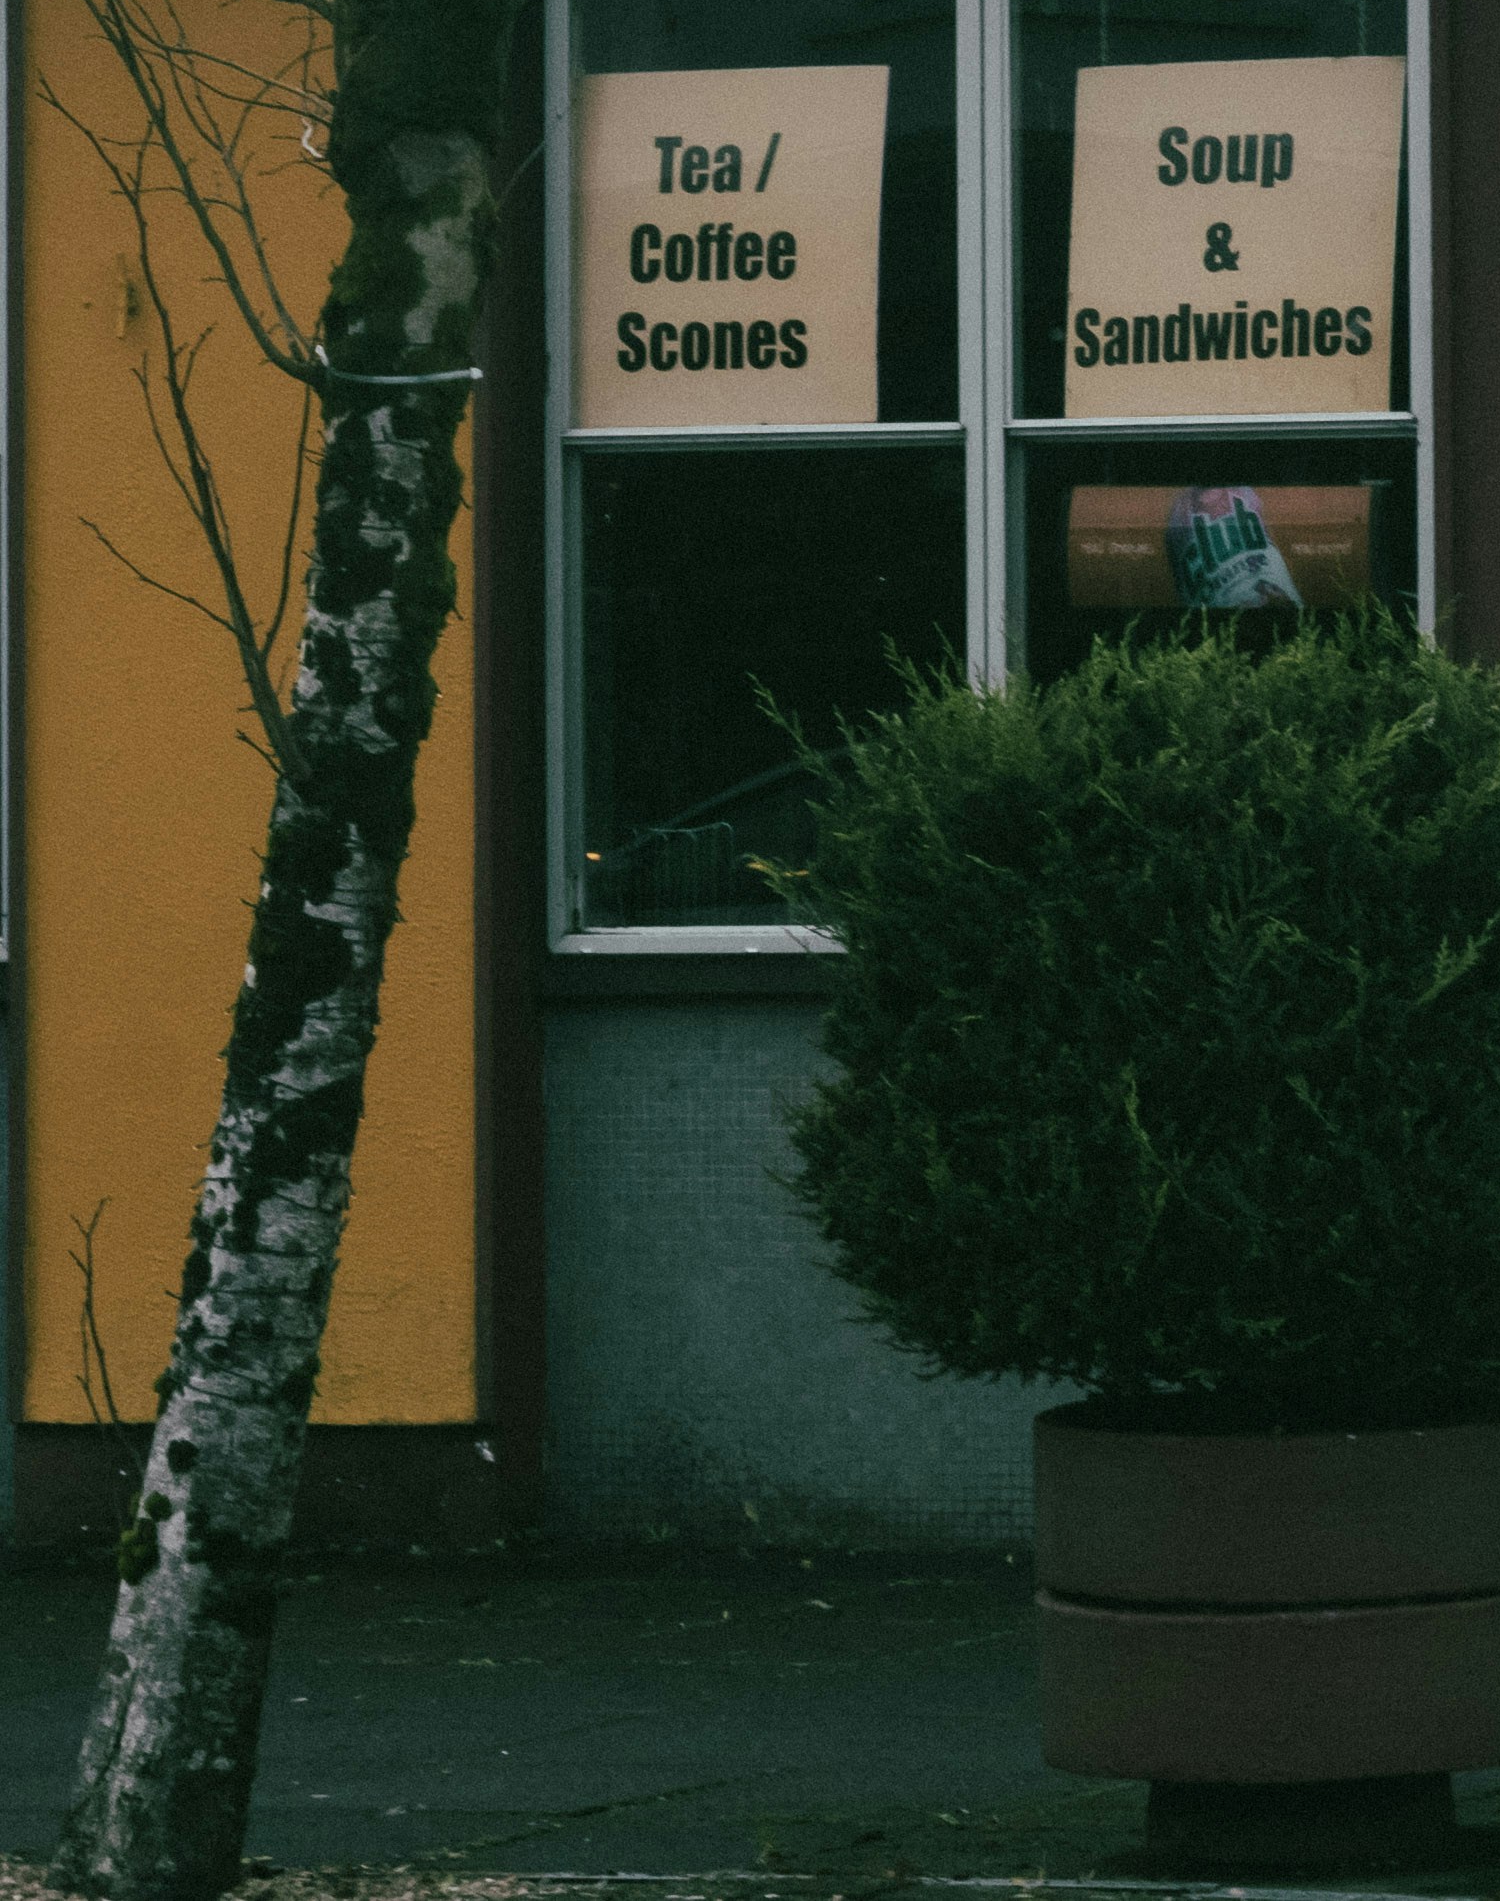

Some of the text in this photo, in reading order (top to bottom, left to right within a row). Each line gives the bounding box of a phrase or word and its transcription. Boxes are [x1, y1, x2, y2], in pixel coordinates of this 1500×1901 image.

[655, 137, 741, 194] Tea
[1158, 127, 1293, 188] Soup
[631, 223, 796, 283] Coffee
[1204, 223, 1239, 272] &
[618, 312, 807, 372] Scones
[1075, 299, 1372, 367] Sandwiches
